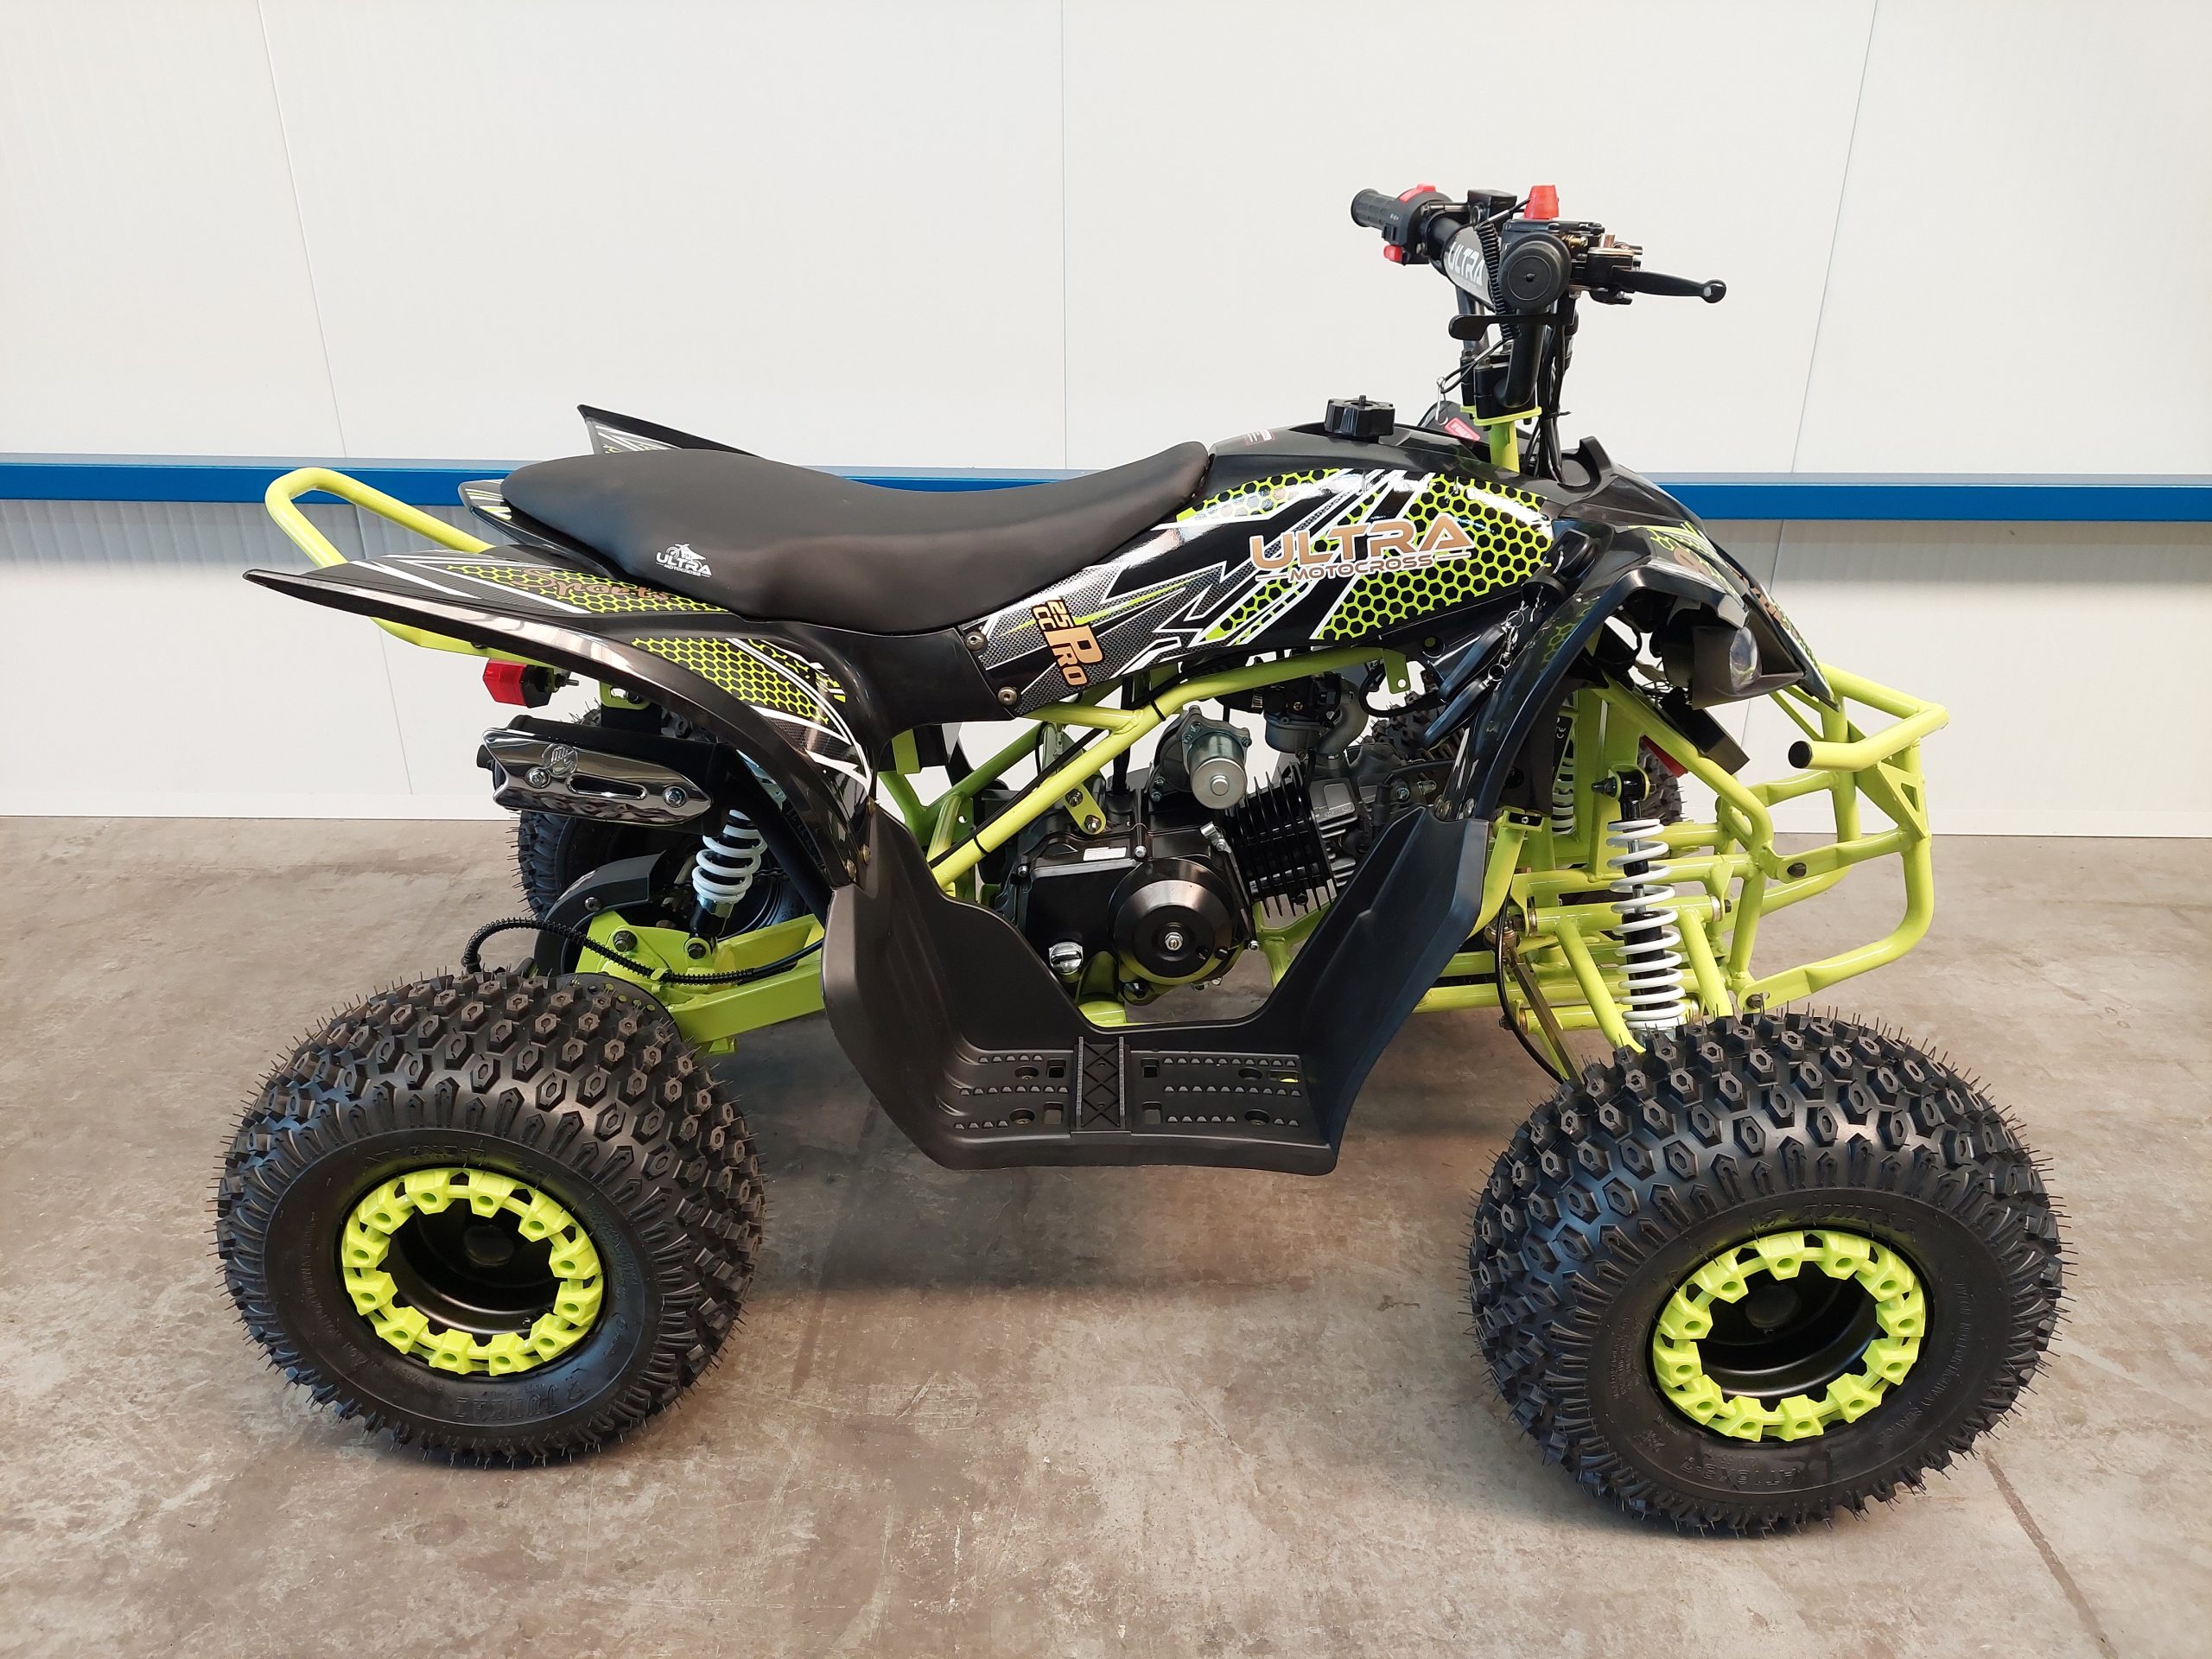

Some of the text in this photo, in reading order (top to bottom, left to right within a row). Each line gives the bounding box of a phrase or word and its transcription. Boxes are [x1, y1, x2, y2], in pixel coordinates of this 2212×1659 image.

[1447, 241, 1486, 287] ULTRA
[1250, 514, 1474, 570] ULTRA
[656, 552, 713, 576] ULTRA
[1289, 554, 1433, 582] MOTOCROSS
[510, 567, 671, 602] Sports
[1033, 606, 1057, 631] CC
[1046, 595, 1074, 628] 25
[1043, 625, 1103, 686] PRO
